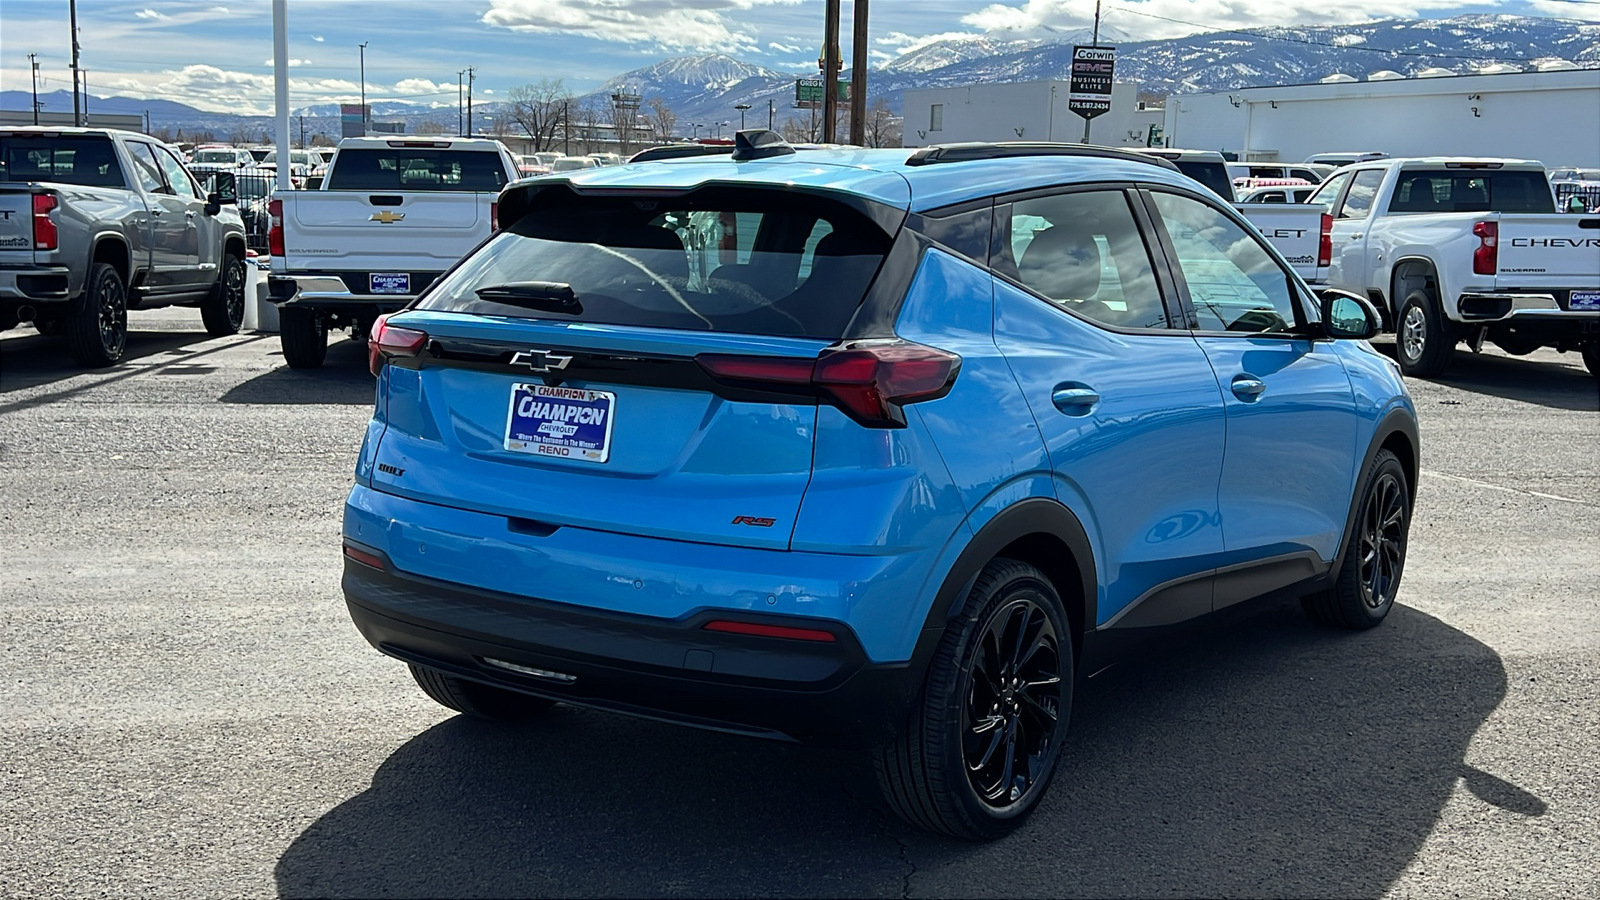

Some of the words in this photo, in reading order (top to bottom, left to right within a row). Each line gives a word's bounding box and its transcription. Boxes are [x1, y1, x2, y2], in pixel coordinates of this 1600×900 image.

[1078, 49, 1114, 59] Corwin
[1074, 62, 1112, 72] GMC
[538, 387, 586, 400] CHAMPION
[517, 396, 605, 426] CHAMPION
[540, 424, 575, 434] CHEVROLET
[538, 445, 570, 456] RENO
[378, 463, 406, 477] BOLT
[731, 515, 777, 528] RS
